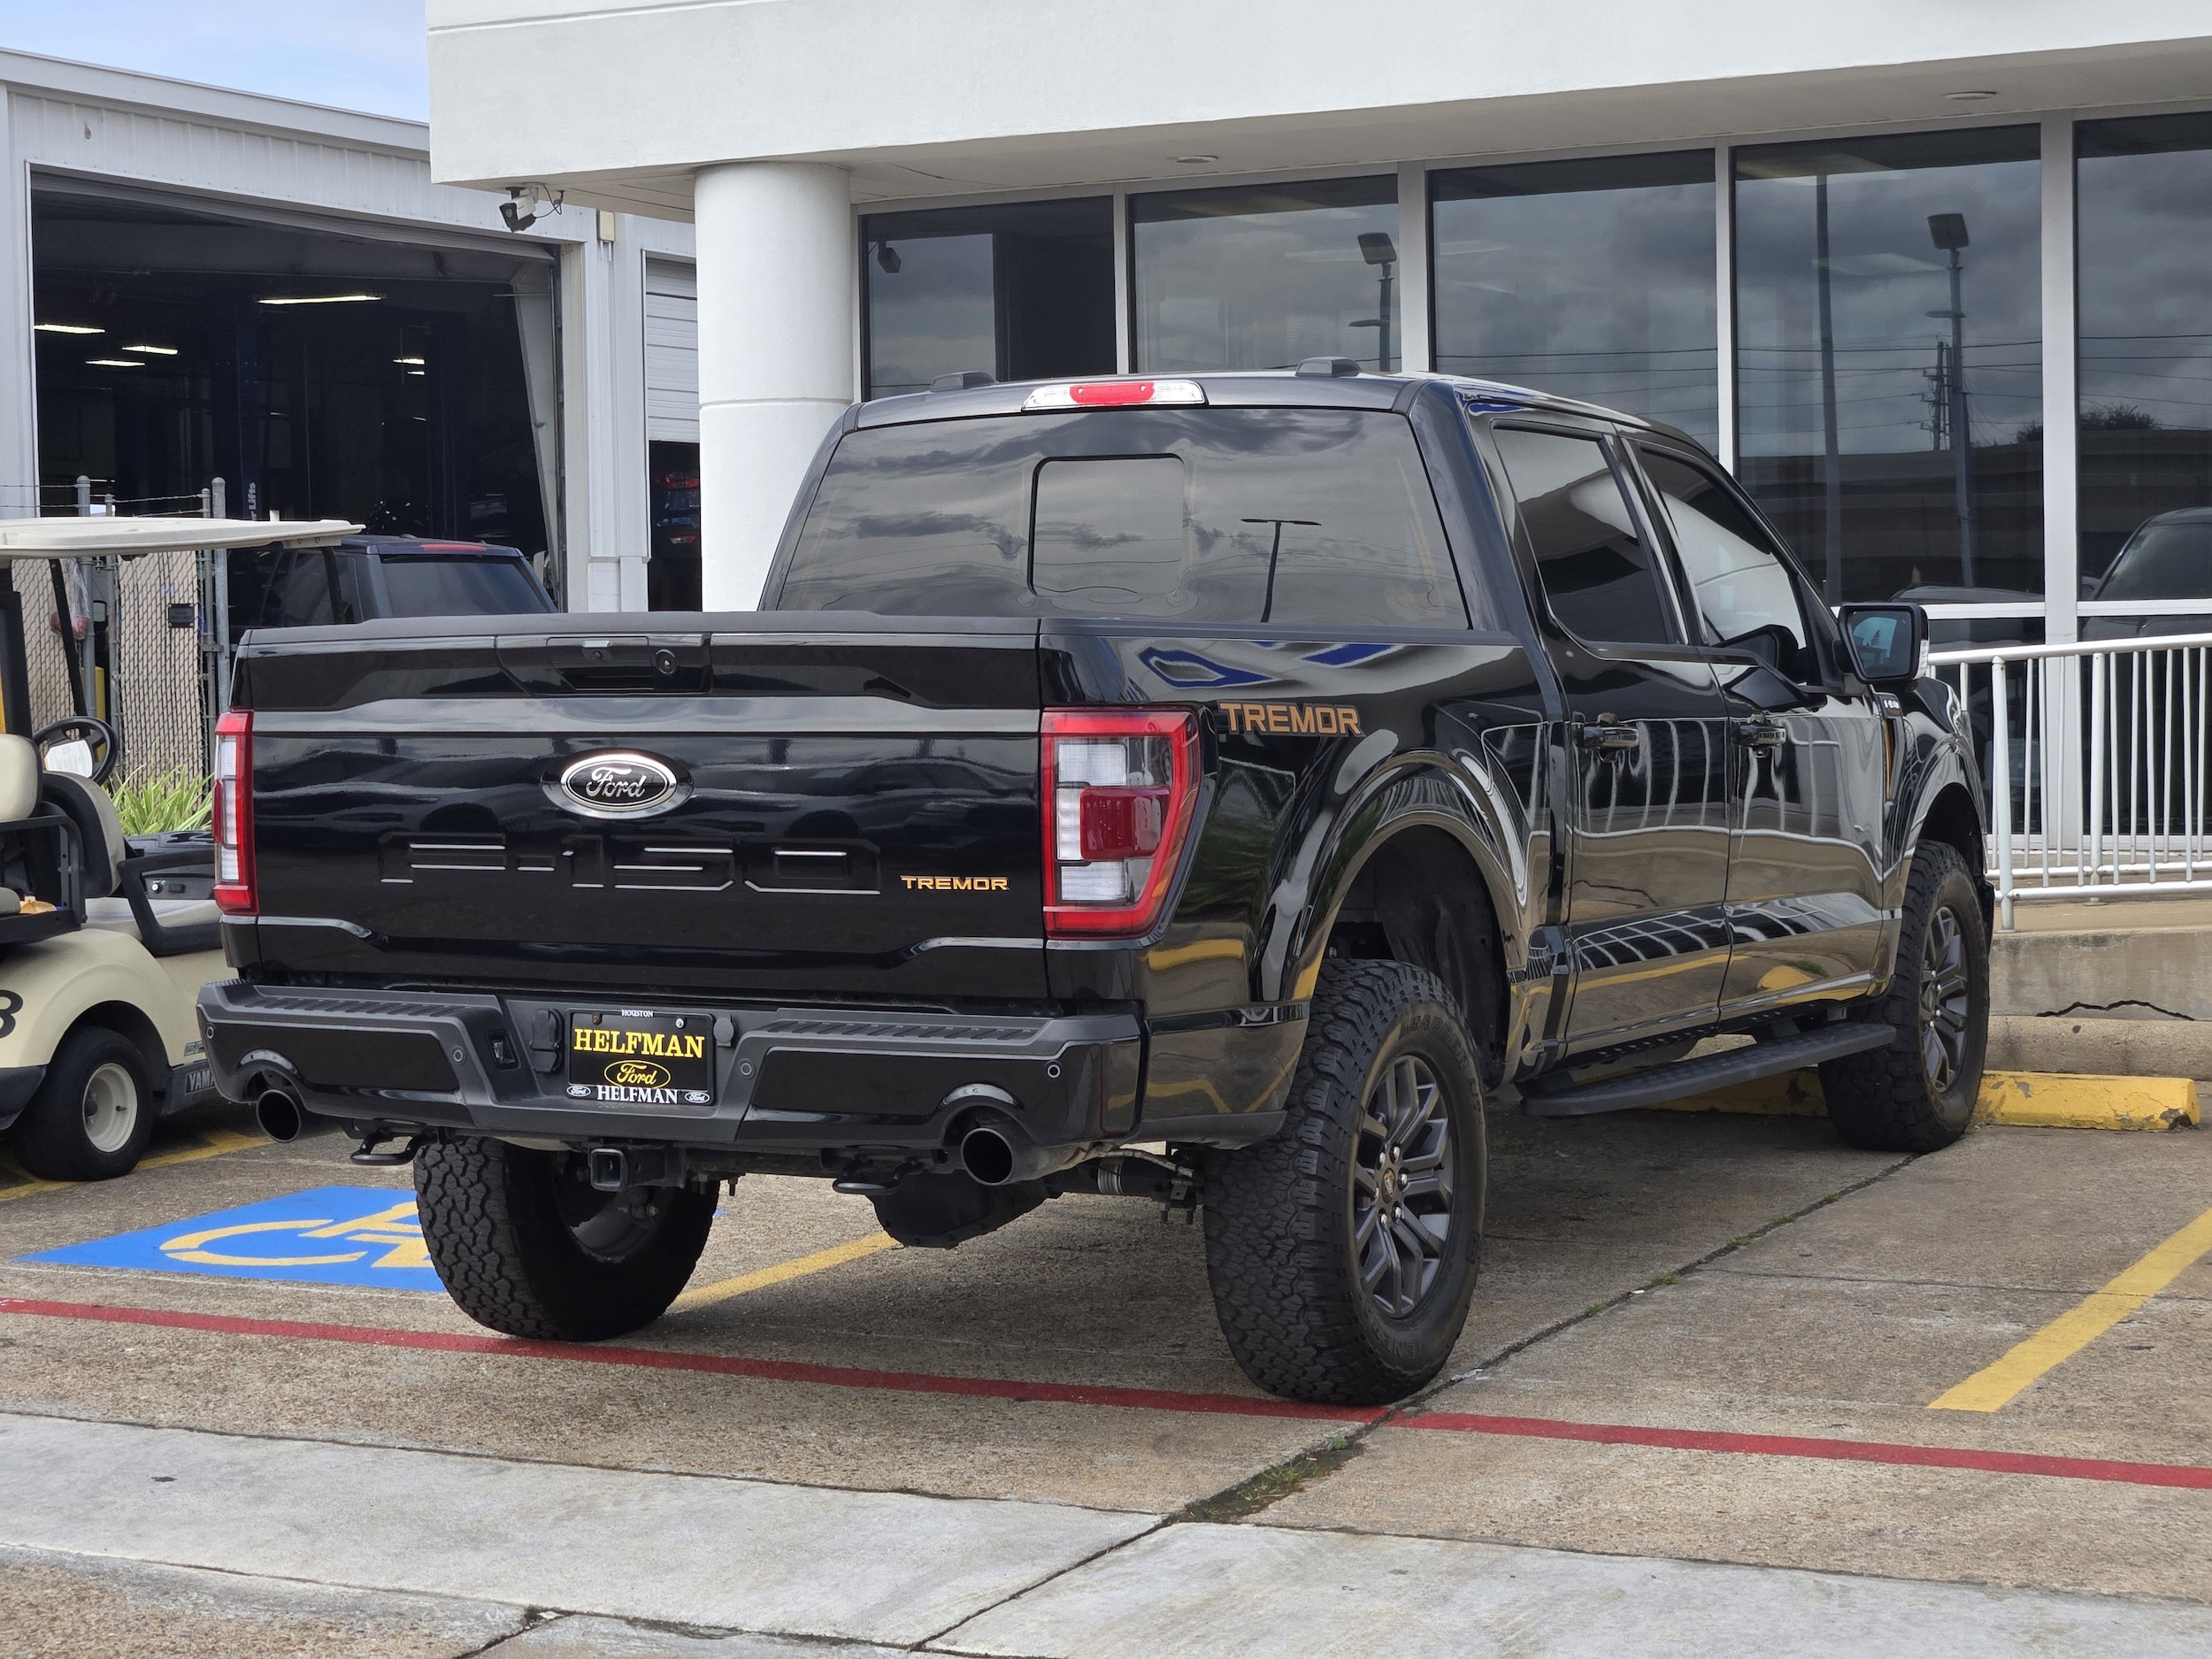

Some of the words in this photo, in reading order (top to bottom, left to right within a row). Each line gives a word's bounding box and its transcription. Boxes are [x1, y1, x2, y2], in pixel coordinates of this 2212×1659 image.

[1218, 702, 1363, 736] TREMOR
[586, 766, 647, 798] Ford
[901, 875, 1010, 891] TREMOR
[621, 1009, 654, 1018] HOUSTON
[573, 1028, 705, 1056] HELFMAN
[617, 1063, 657, 1085] Ford
[596, 1085, 679, 1104] HELFMAN
